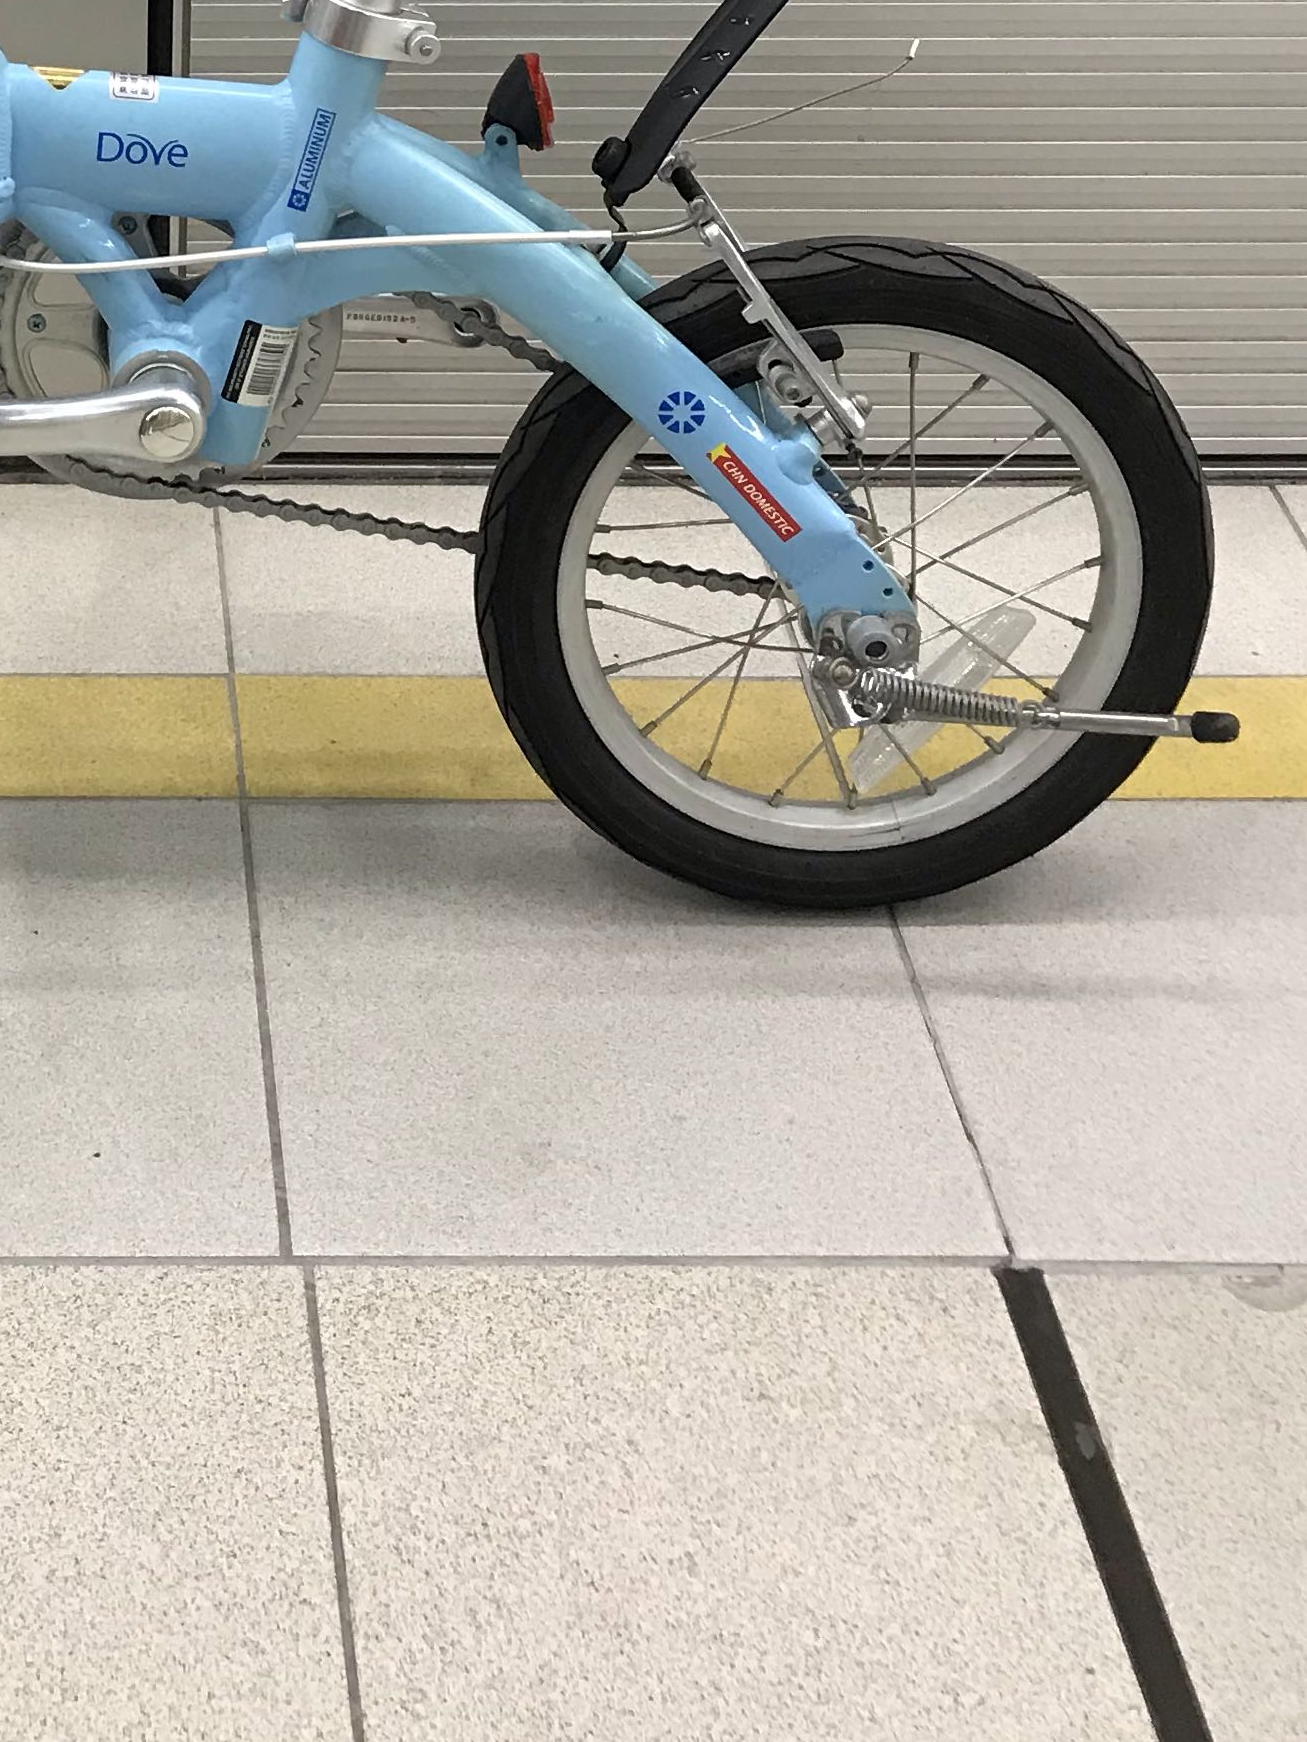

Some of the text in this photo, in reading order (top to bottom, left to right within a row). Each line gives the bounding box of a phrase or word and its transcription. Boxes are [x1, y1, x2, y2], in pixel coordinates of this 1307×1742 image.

[96, 131, 189, 167] Dove
[298, 113, 332, 190] ALUMINUM
[722, 461, 795, 536] CHN DOMESTIC
